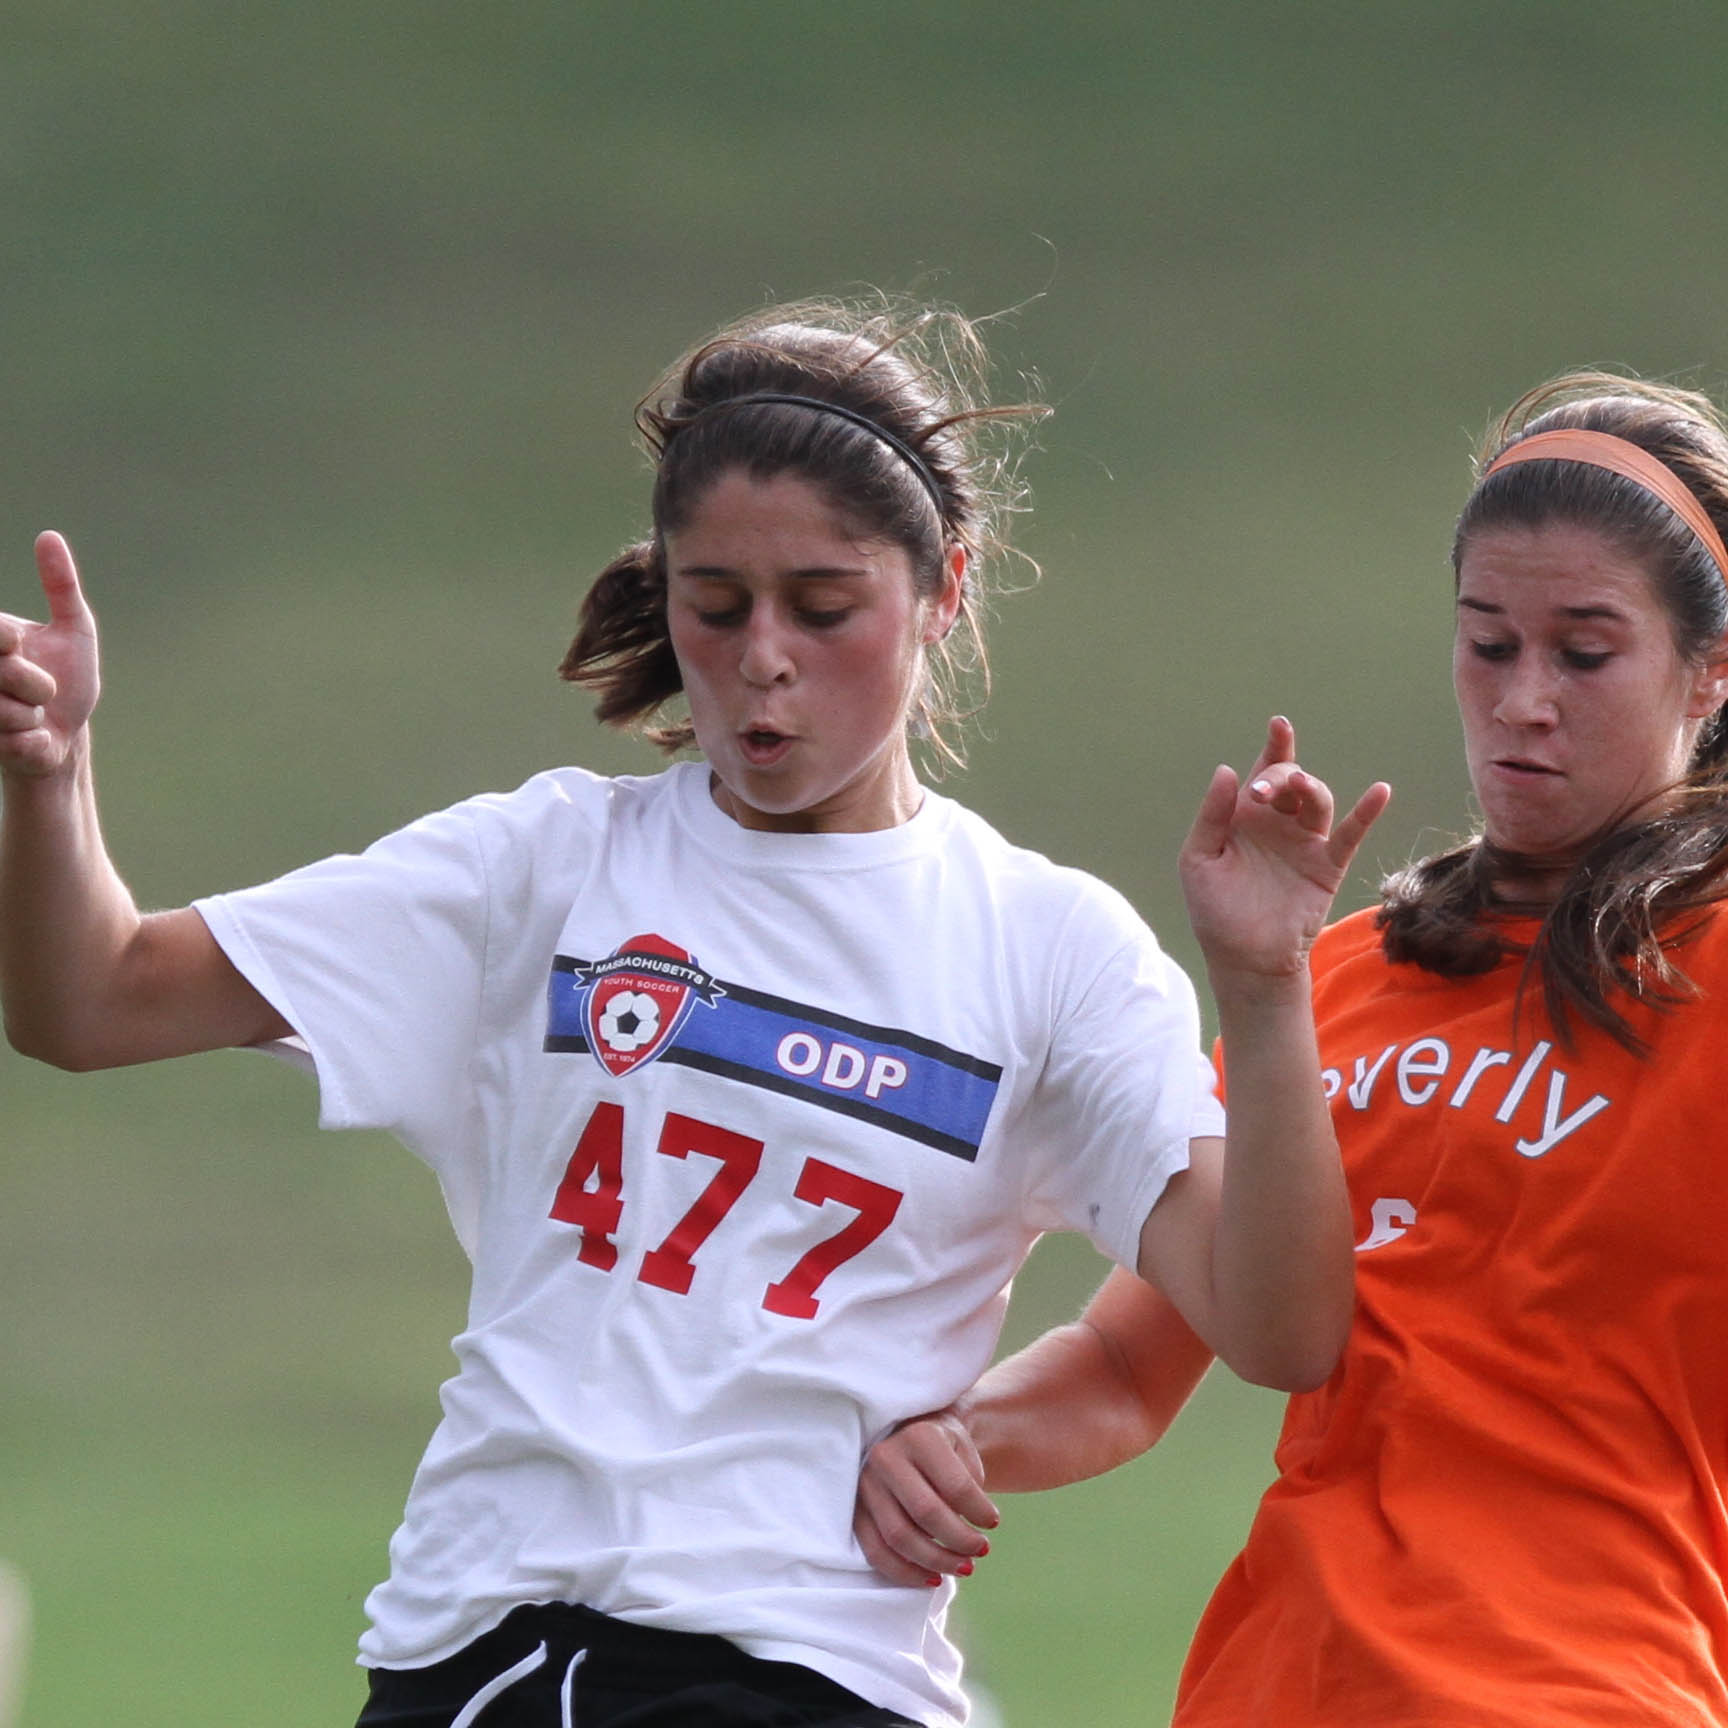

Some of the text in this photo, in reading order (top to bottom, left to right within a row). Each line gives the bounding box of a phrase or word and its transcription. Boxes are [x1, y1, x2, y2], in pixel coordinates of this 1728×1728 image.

[595, 956, 705, 985] MASSACHUSETTS
[604, 977, 680, 993] YOUTH SOCCER
[776, 1031, 909, 1099] ODP
[548, 1101, 904, 1320] 477
